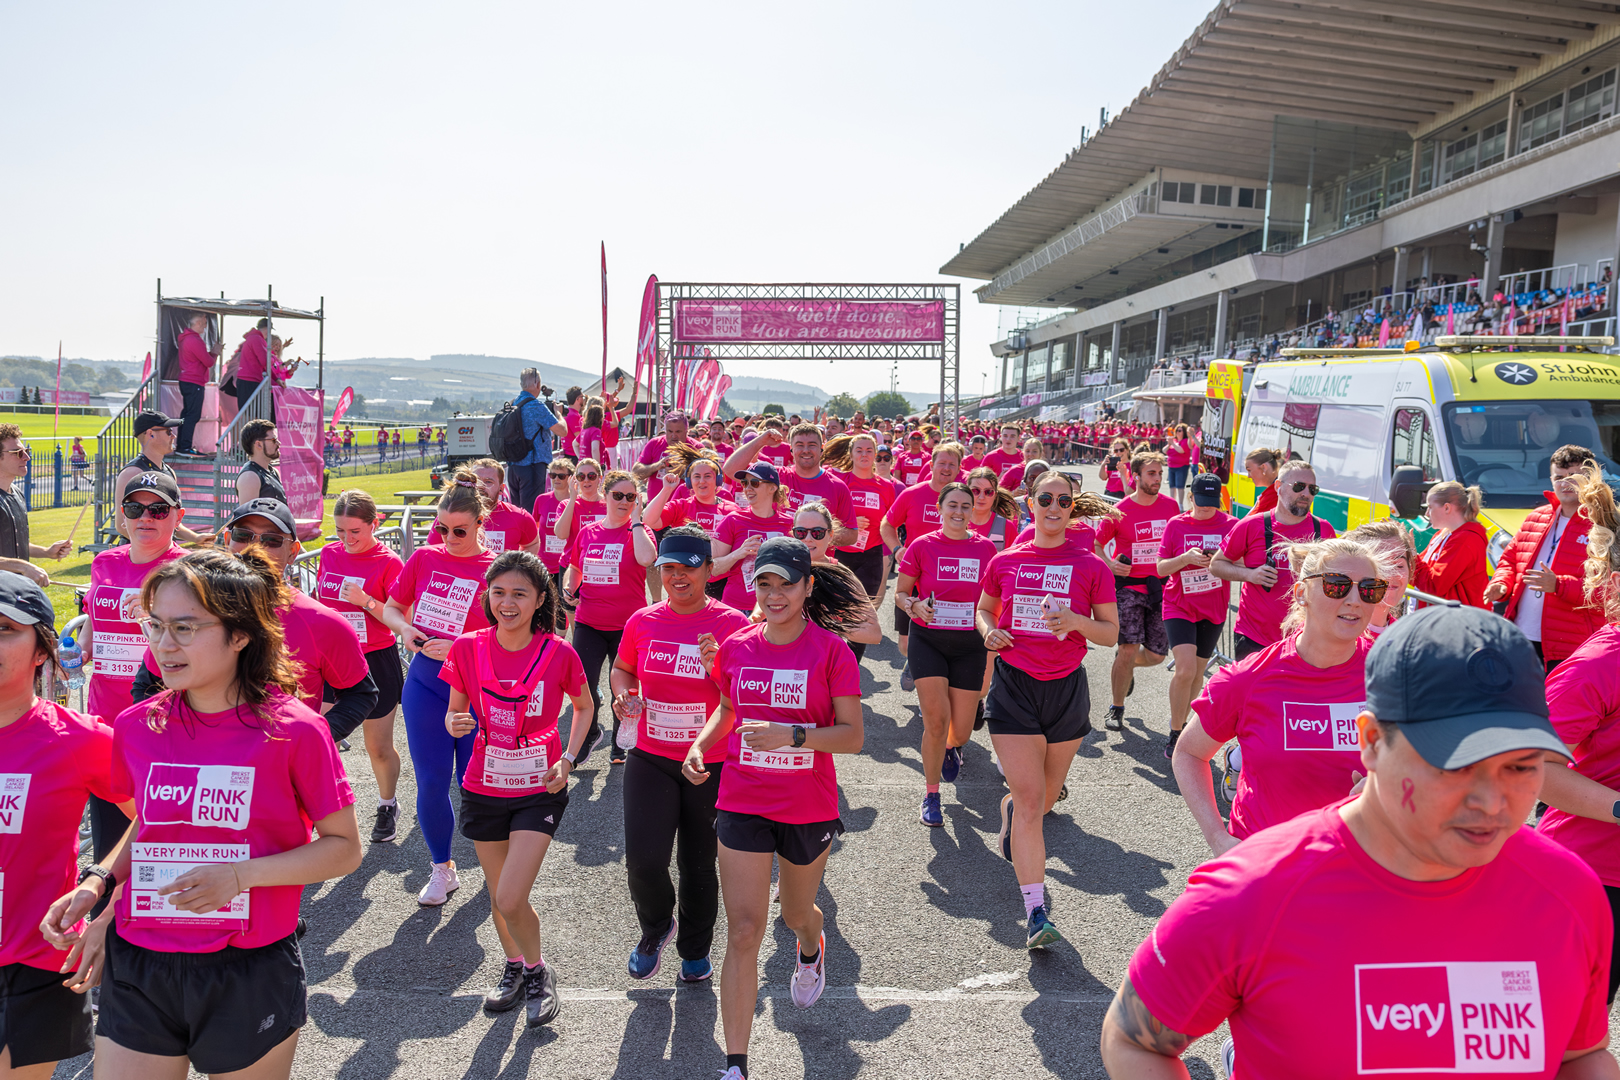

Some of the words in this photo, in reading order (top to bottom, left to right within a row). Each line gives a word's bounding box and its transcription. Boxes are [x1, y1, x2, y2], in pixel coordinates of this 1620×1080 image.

[847, 305, 903, 322] done.
[687, 314, 712, 327] very
[715, 315, 741, 325] PINK
[715, 325, 737, 334] RUN
[752, 322, 793, 340] You
[801, 327, 834, 339] are
[1287, 375, 1352, 397] AMBULANCE
[925, 510, 940, 518] very
[697, 517, 714, 525] very
[1137, 527, 1152, 535] very
[1187, 539, 1203, 547] very
[939, 565, 959, 574] very
[960, 566, 978, 574] PINK
[1020, 571, 1043, 581] very
[1046, 572, 1069, 582] PINK
[1193, 574, 1209, 583] LIZ
[323, 581, 341, 592] very
[430, 580, 451, 592] very
[451, 585, 473, 596] PINK
[1045, 580, 1065, 590] RUN
[450, 592, 470, 603] RUN
[95, 597, 119, 610] very
[428, 619, 445, 630] 2539
[117, 635, 135, 643] PINK
[106, 645, 130, 656] Robin
[650, 651, 676, 664] very
[111, 663, 134, 673] 3139
[677, 664, 701, 675] RUN
[740, 680, 770, 694] very
[774, 682, 804, 694] PINK
[774, 693, 800, 705] RUN
[1288, 718, 1329, 735] very
[664, 730, 685, 739] 1325
[490, 747, 506, 757] VERY
[506, 749, 523, 758] PINK
[525, 748, 541, 756] RUN
[764, 755, 789, 769] 4714
[503, 777, 526, 786] 1096
[149, 784, 194, 806] very
[200, 788, 247, 806] PINK
[198, 805, 239, 823] RUN
[144, 847, 176, 857] VERY
[179, 847, 209, 858] PINK
[212, 848, 239, 859] RUN
[1365, 1002, 1446, 1038] very
[1460, 1002, 1537, 1030] PINK
[1464, 1033, 1531, 1061] RUN
